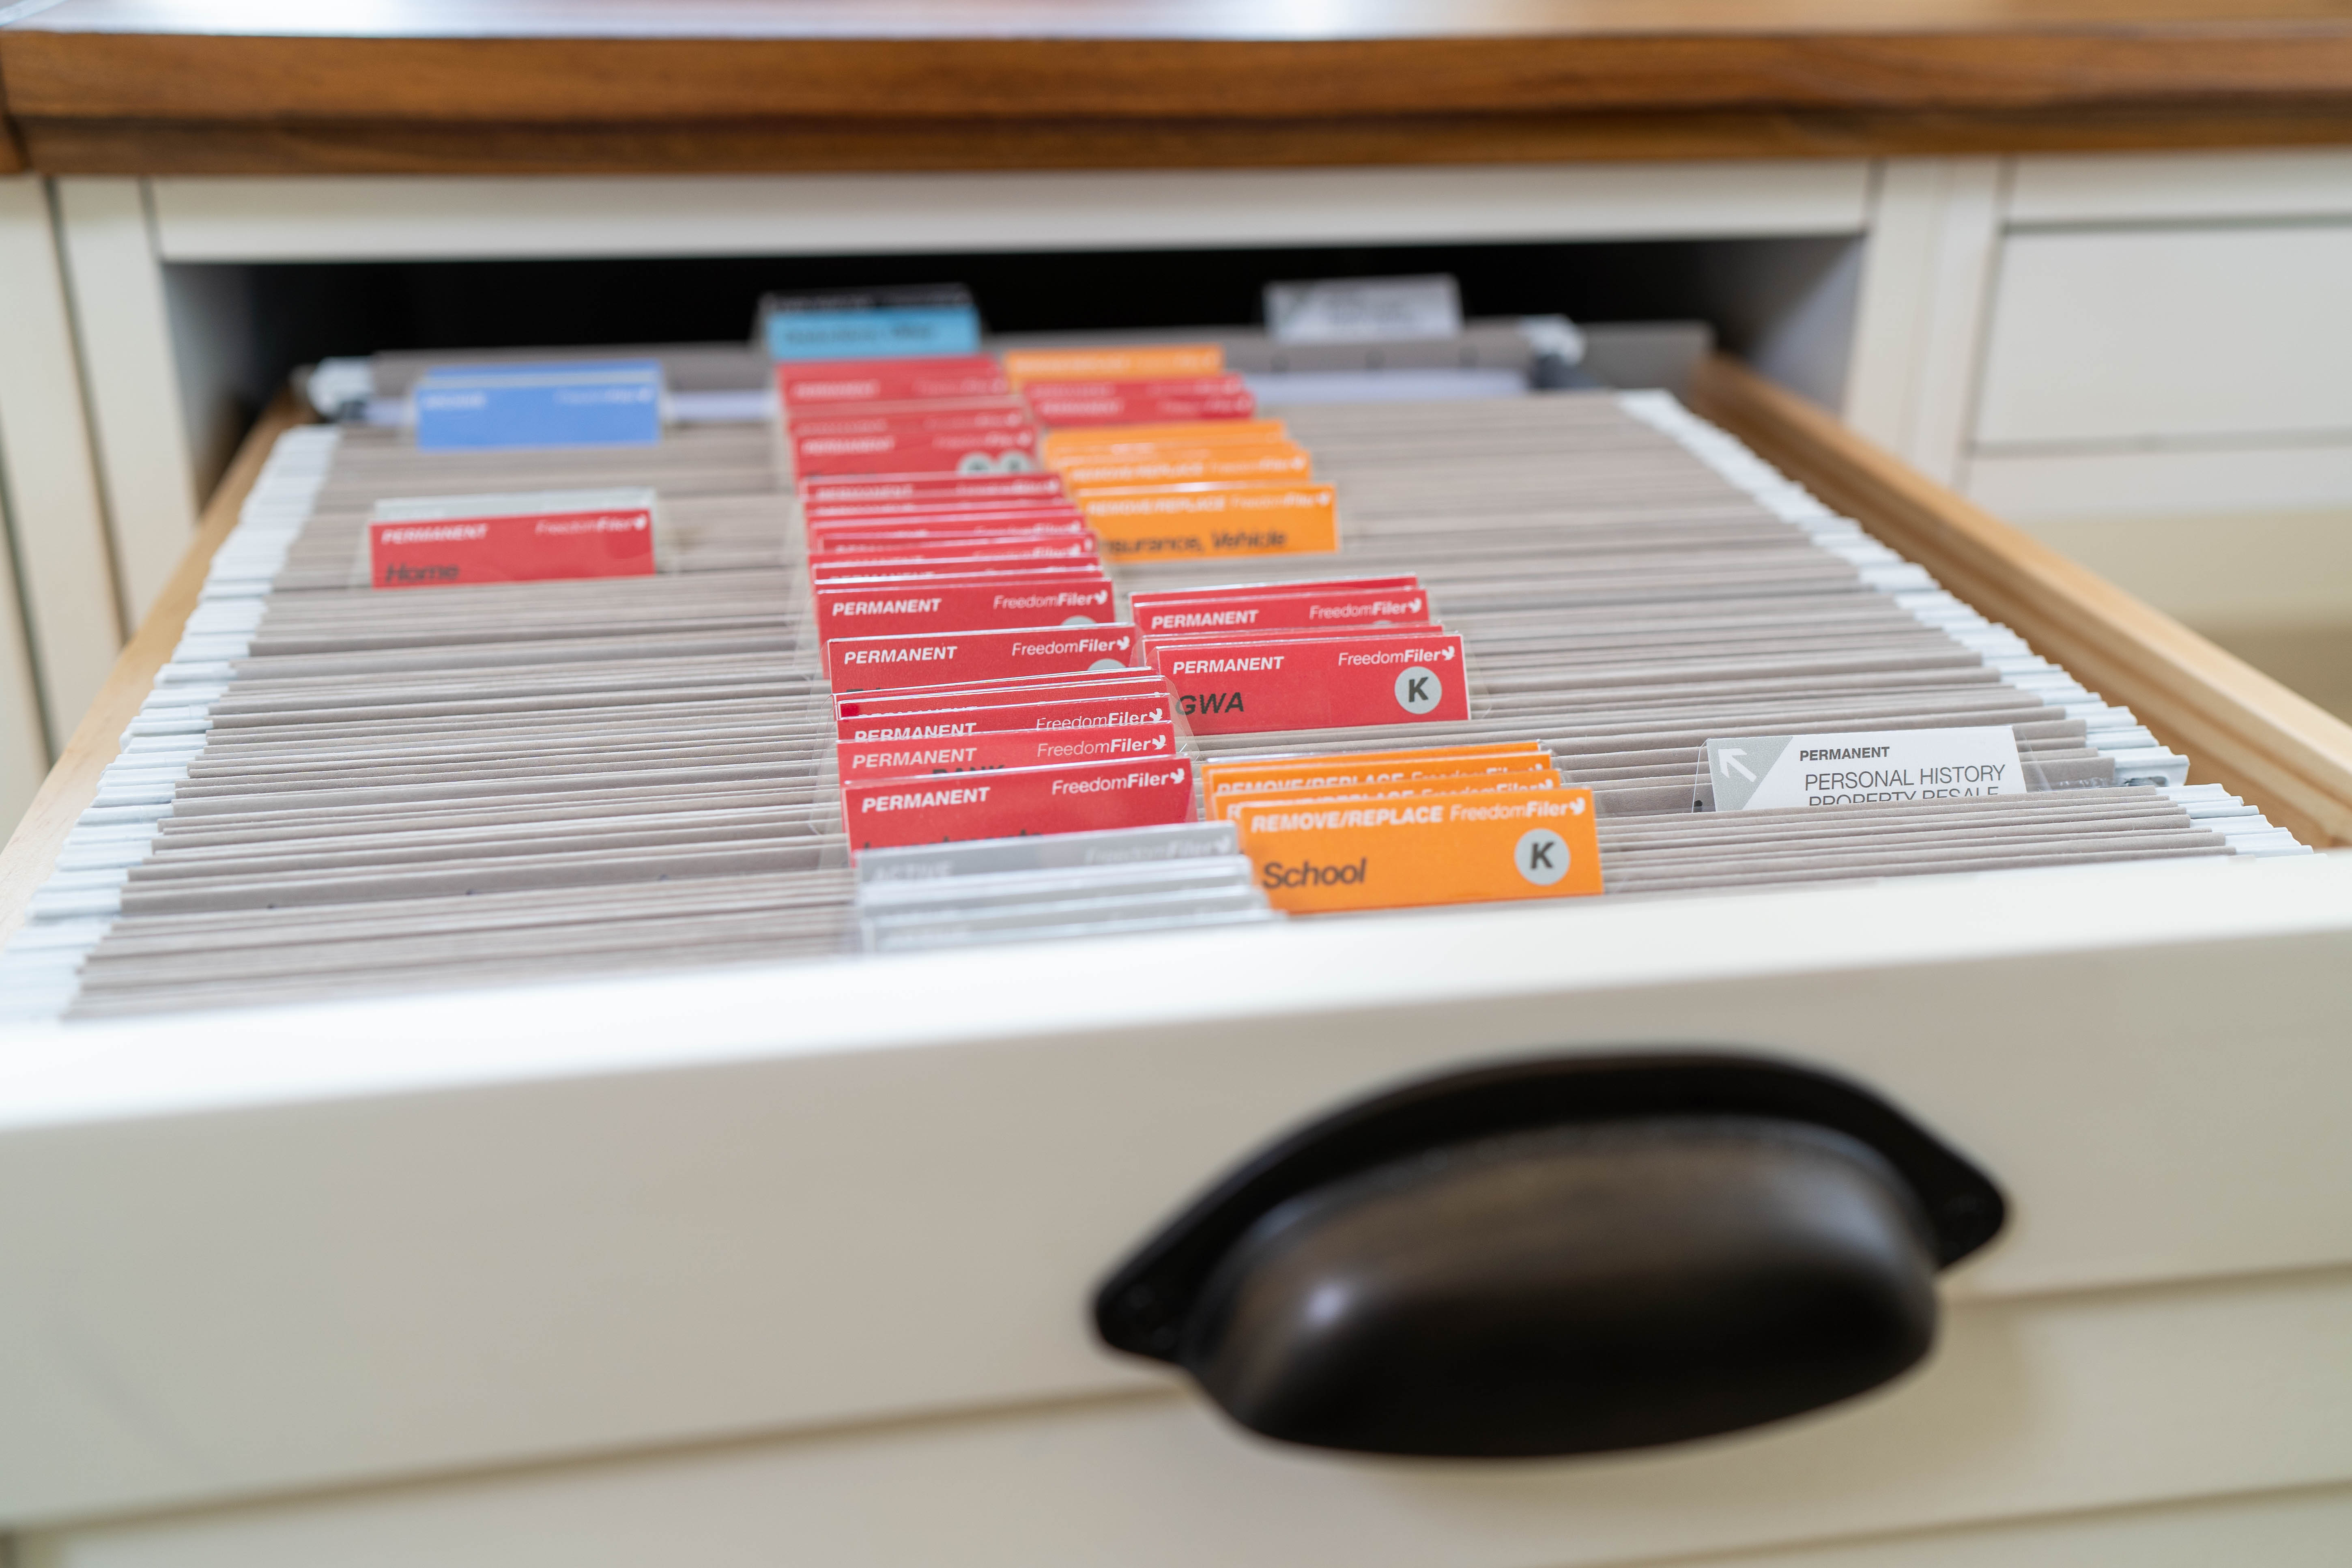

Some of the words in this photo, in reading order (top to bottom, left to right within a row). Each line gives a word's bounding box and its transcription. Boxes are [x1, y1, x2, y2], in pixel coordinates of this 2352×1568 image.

[381, 523, 488, 544] PERMANENT
[385, 562, 460, 584] Home
[832, 598, 942, 616] PERMANENT
[993, 592, 1094, 610] FreedomFiler
[1151, 609, 1259, 630] PERMANENT
[1309, 600, 1409, 619] FreedomFiler
[844, 645, 958, 665] PERMANENT
[1012, 638, 1116, 657] FreedomFiler
[1173, 656, 1285, 675] PERMANENT
[1338, 649, 1441, 667] FreedomFiler
[1408, 676, 1429, 703] K
[1175, 692, 1245, 716] GWA
[854, 722, 977, 741] PERMANENT
[1036, 712, 1148, 729] FreedomFiler
[852, 748, 977, 769] PERMANENT
[1037, 738, 1151, 757] FreedomFiler
[1799, 746, 1890, 761] PERMANENT
[1805, 769, 1914, 791] PERSONAL
[1920, 764, 2006, 785] HISTORY
[862, 787, 991, 813] PERMANENT
[1051, 773, 1169, 795] FreedomFiler
[1251, 805, 1443, 833] REMOVE/REPLACE
[1449, 800, 1569, 822] FreedomFiler
[1530, 841, 1555, 870] K
[1262, 858, 1367, 890] School
